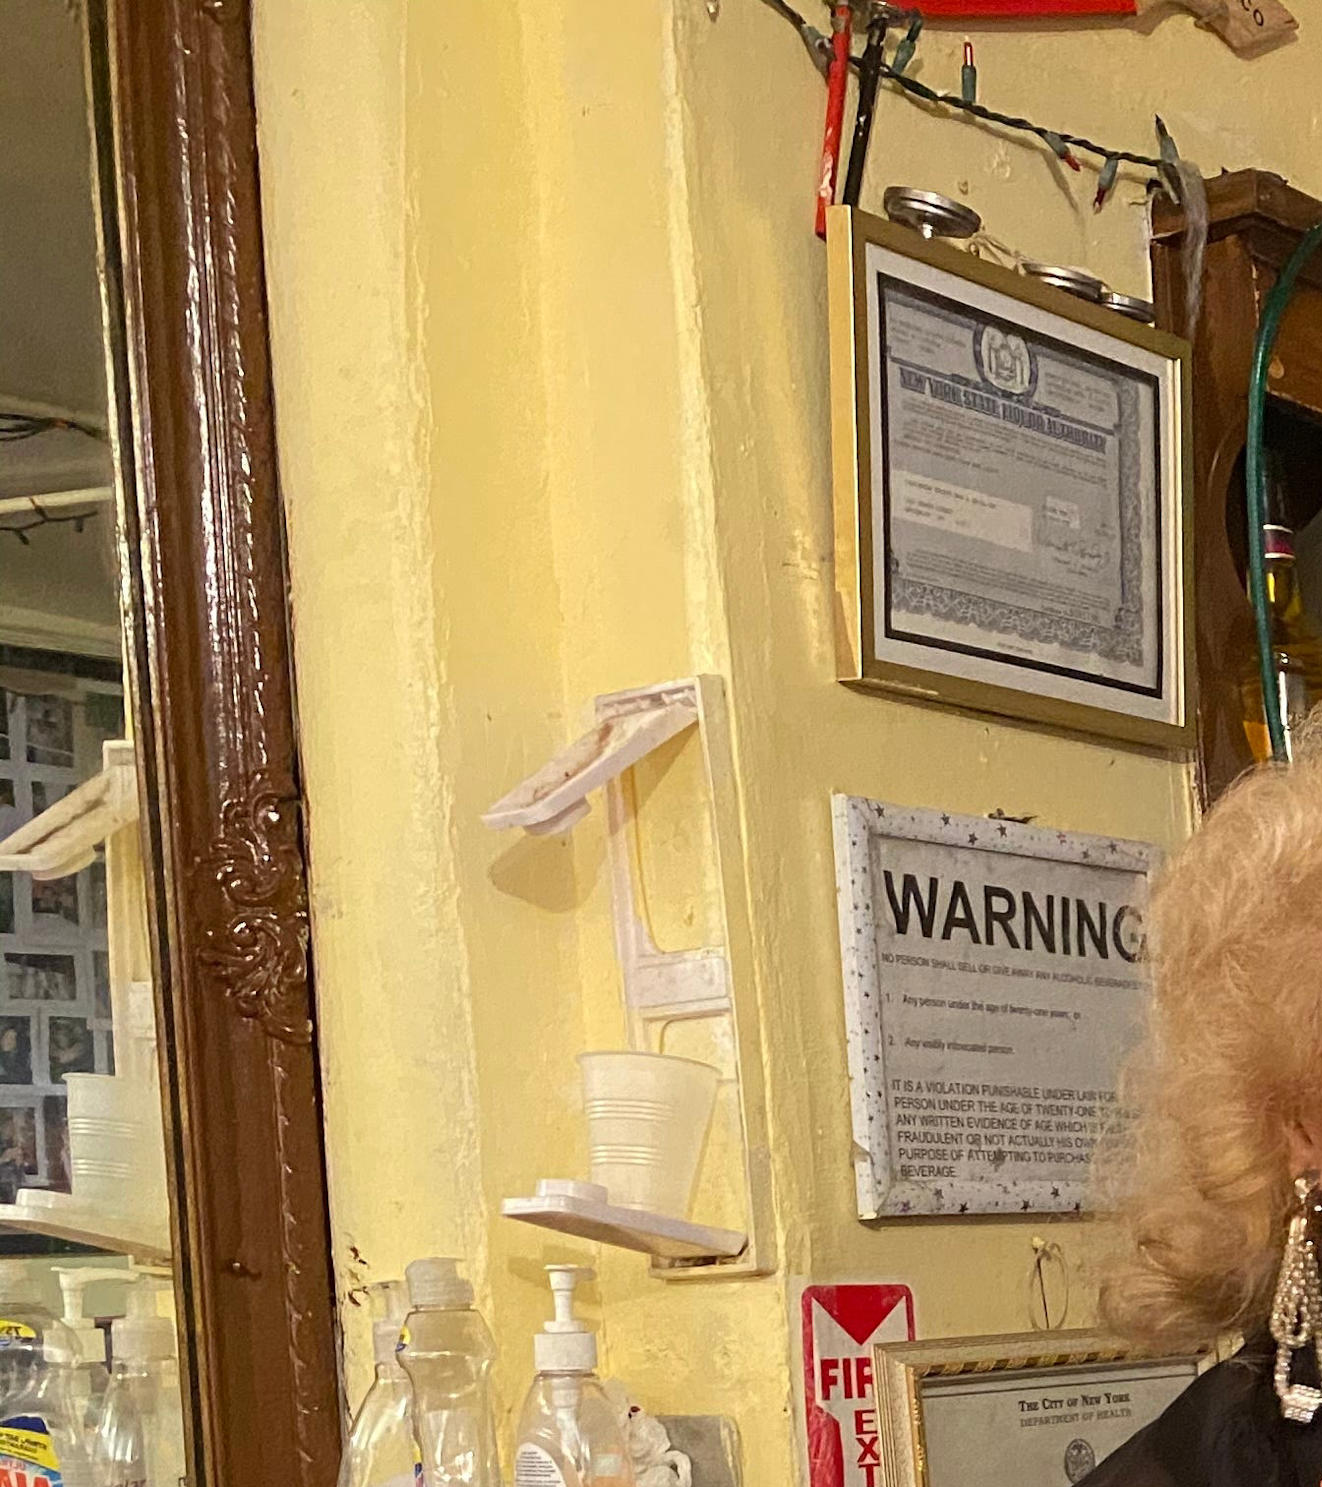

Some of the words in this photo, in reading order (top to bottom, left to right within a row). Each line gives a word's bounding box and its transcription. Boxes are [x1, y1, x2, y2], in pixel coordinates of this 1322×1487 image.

[883, 869, 1147, 963] WARNING
[895, 954, 930, 967] PERSON
[891, 1079, 901, 1091] IT
[903, 1080, 914, 1092] IS
[915, 1081, 924, 1093] A
[924, 1081, 980, 1095] VIOLATION
[981, 1084, 1040, 1099] PUNISHABLE
[1042, 1088, 1076, 1101] UNDER
[894, 1096, 936, 1110] PERSON
[938, 1099, 976, 1112] UNDER
[976, 1100, 999, 1113] THE
[1000, 1101, 1019, 1114] AGE
[1020, 1102, 1033, 1115] OF
[1034, 1103, 1097, 1117] TWENTY-ONE
[895, 1113, 917, 1126] ANY
[919, 1115, 964, 1129] WRITTEN
[966, 1116, 1018, 1130] EVIDENCE
[1019, 1119, 1032, 1131] OF
[1034, 1120, 1054, 1132] AGE
[1054, 1121, 1087, 1133] WHICH
[897, 1130, 964, 1145] FRAUDULENT
[966, 1133, 981, 1146] OR
[983, 1134, 1006, 1146] NOT
[1007, 1134, 1056, 1148] ACTUALLY
[1056, 1137, 1073, 1149] HIS
[898, 1147, 949, 1161] PURPOSE
[950, 1149, 965, 1161] OF
[967, 1149, 1032, 1163] ATTEMPTING
[1032, 1151, 1047, 1163] TO
[1047, 1152, 1093, 1164] PURCHAS
[1018, 1400, 1039, 1412] THE
[1042, 1398, 1064, 1410] CITY
[1081, 1394, 1102, 1407] NEW
[1104, 1392, 1131, 1404] YORK
[1019, 1412, 1080, 1428] DEPARTMENT
[1081, 1411, 1094, 1422] OF
[1096, 1407, 1132, 1420] HEALTH
